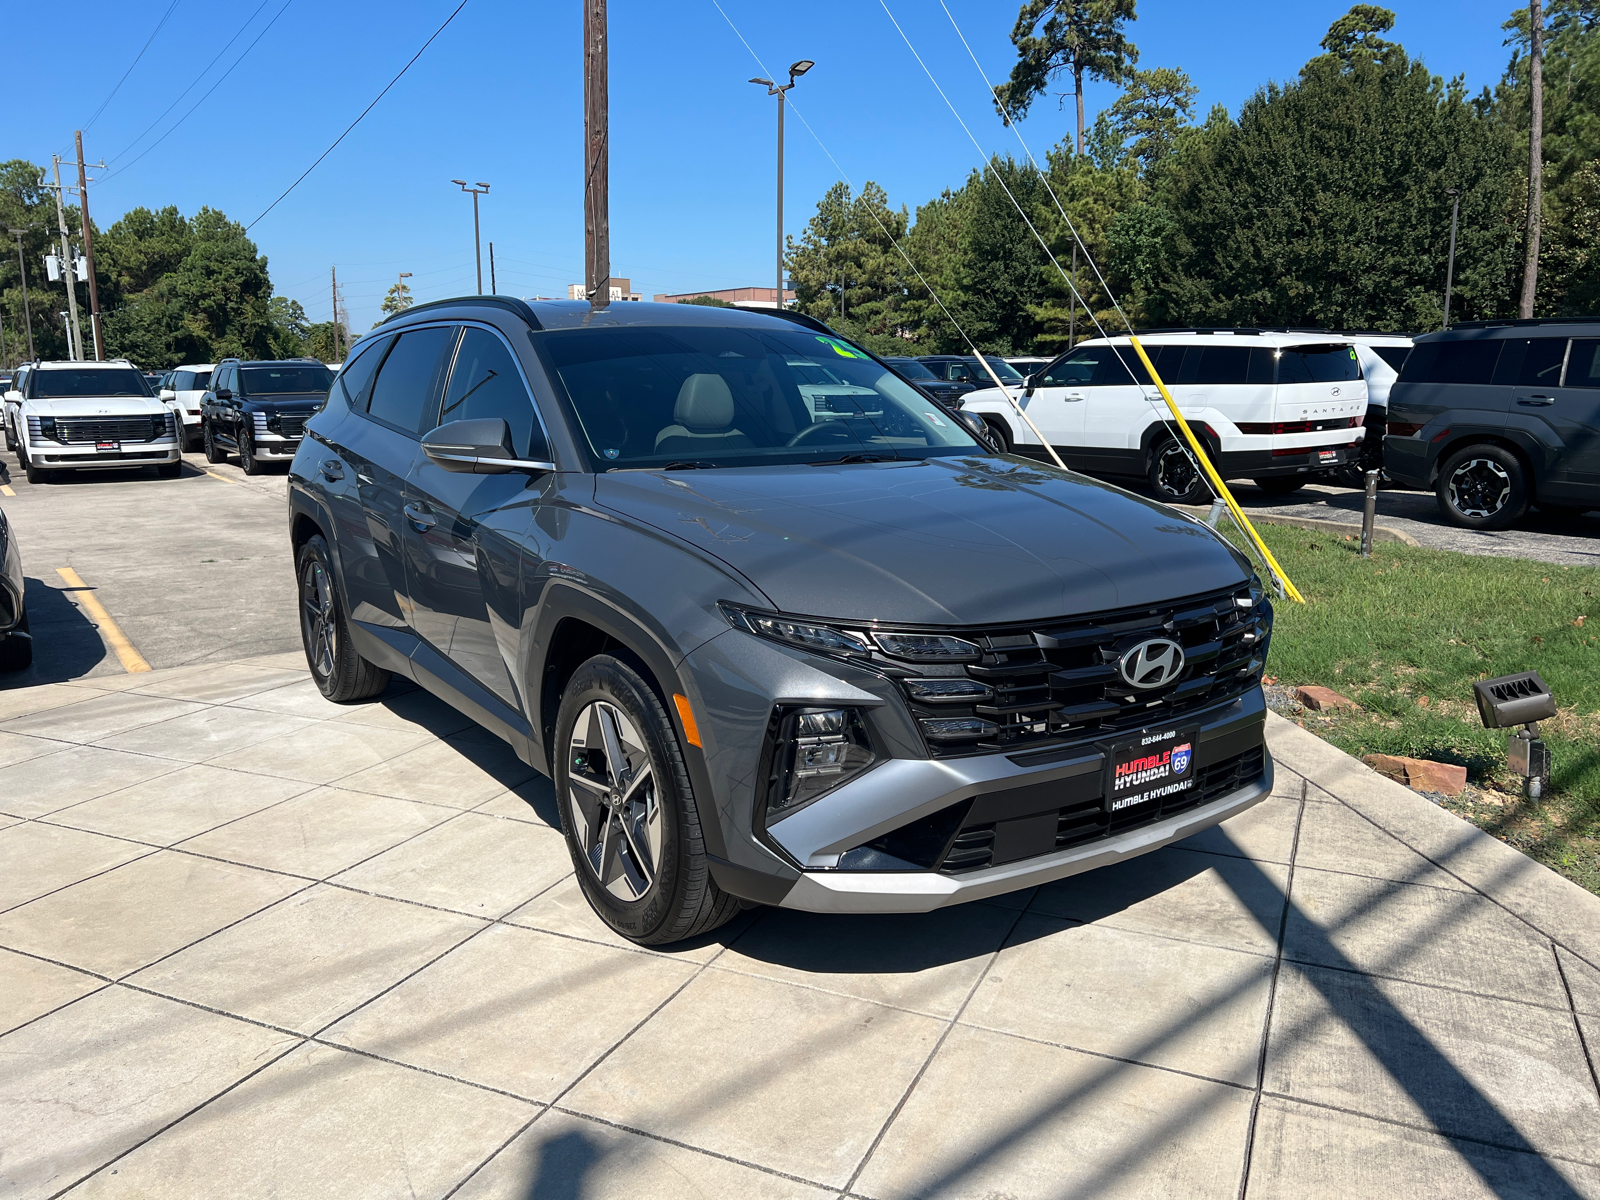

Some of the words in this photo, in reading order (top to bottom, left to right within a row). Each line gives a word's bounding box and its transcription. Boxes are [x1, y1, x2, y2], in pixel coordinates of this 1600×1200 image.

[1115, 751, 1170, 777] HUMBLE
[1174, 755, 1188, 771] 69
[1114, 763, 1170, 790] HYUNDAI
[1112, 792, 1149, 811] HUMBLE
[1150, 780, 1187, 800] HYUNDAI
